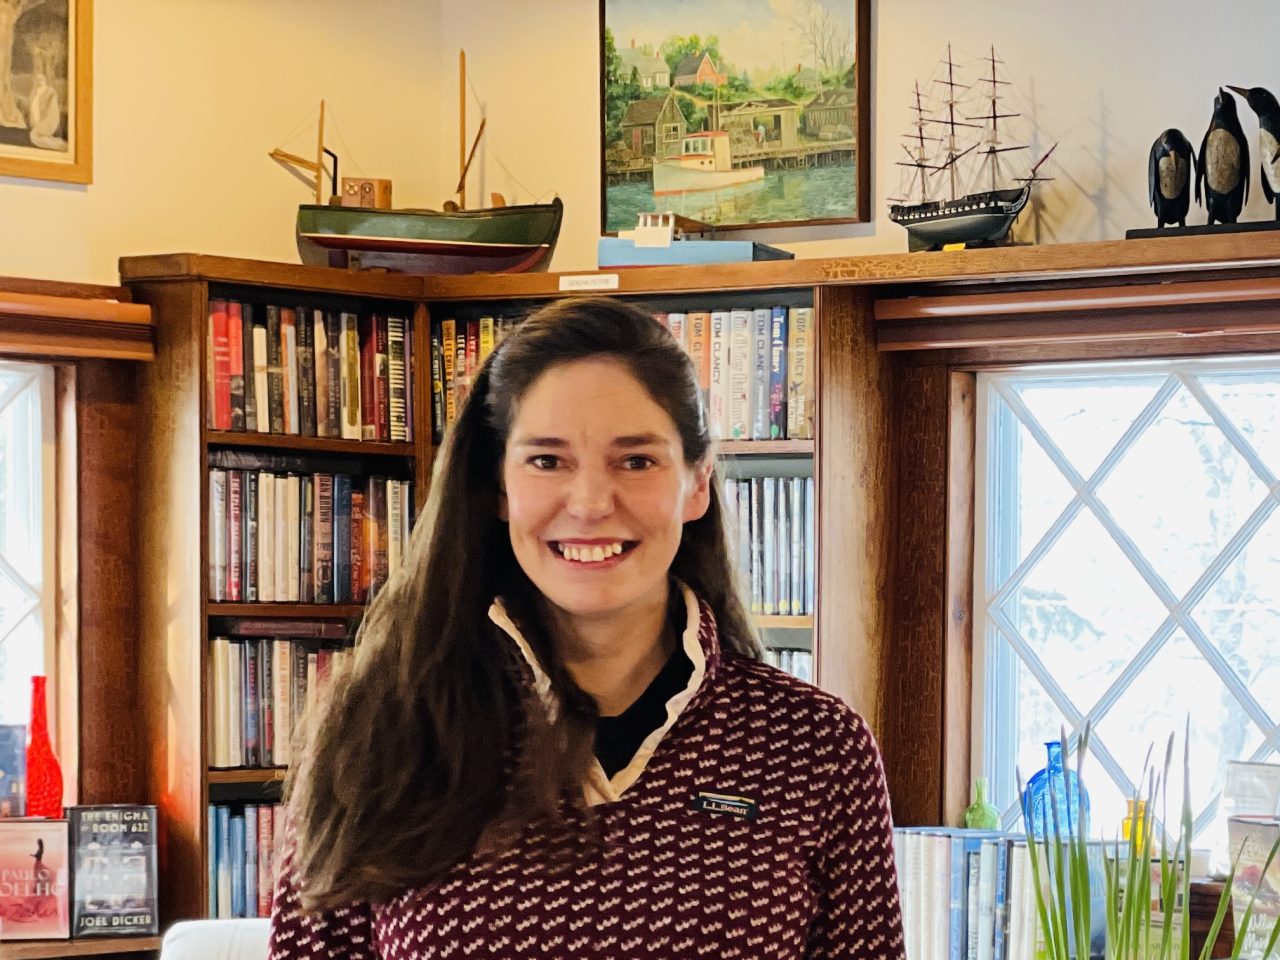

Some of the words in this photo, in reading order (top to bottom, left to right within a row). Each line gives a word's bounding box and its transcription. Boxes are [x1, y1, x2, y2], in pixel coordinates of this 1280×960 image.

[693, 317, 703, 338] TOM
[713, 317, 723, 339] TOM
[756, 314, 765, 337] TOM
[772, 316, 785, 338] Tom
[797, 310, 806, 333] TOM
[457, 334, 466, 349] LEE
[711, 341, 722, 385] CLANCY
[754, 339, 765, 383] CLANCY
[771, 339, 784, 374] Clancy
[794, 336, 806, 378] CLANCY
[318, 477, 331, 493] DAN
[318, 495, 331, 524] BROWN
[81, 811, 99, 821] THE
[105, 811, 149, 821] ENIGMA
[92, 823, 128, 833] ROOM
[131, 823, 149, 833] 622
[2, 868, 50, 881] PAULO
[111, 915, 152, 927] DICKER
